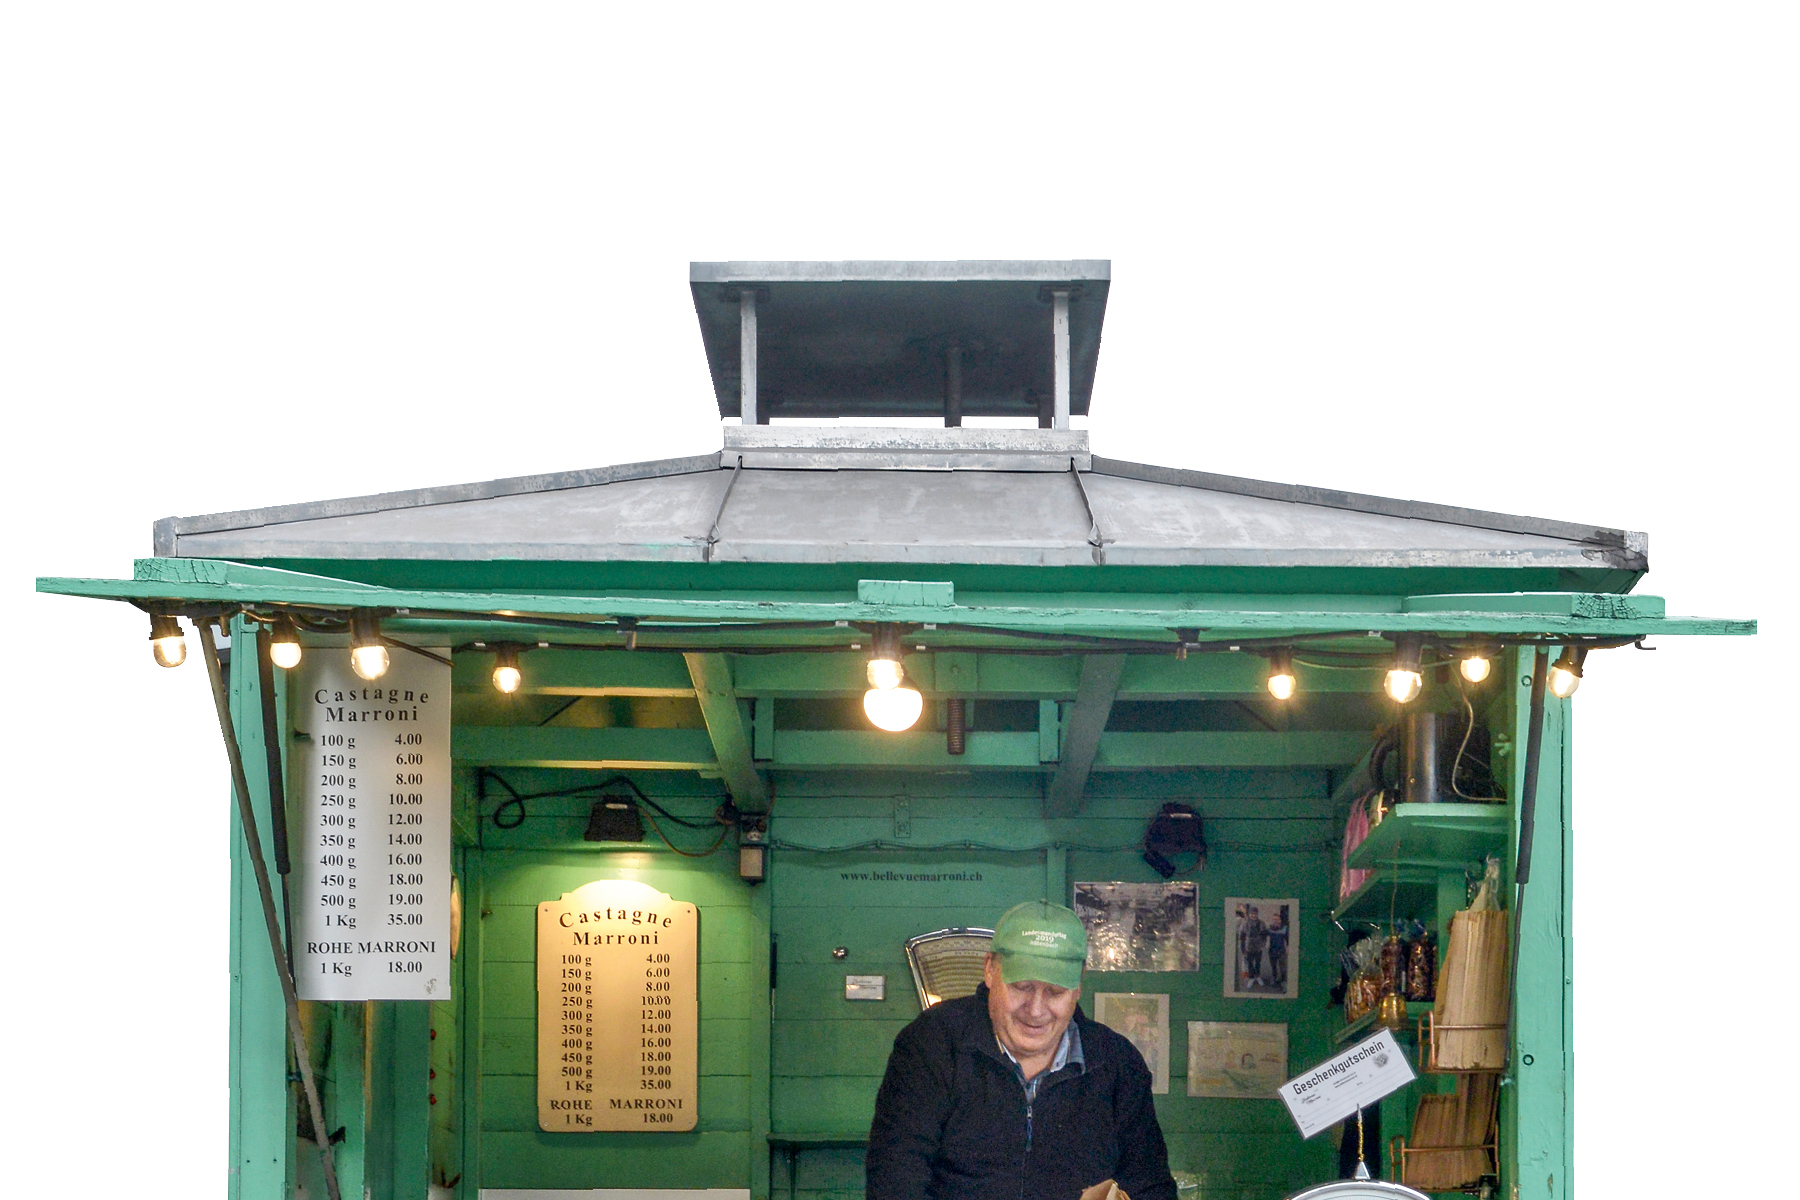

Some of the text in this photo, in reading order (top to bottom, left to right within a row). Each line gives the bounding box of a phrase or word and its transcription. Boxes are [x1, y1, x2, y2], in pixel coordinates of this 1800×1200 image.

[314, 688, 428, 704] Castagne
[326, 706, 417, 721] Marroni
[321, 734, 422, 749] 100 g 4.00
[322, 754, 422, 769] 150 g 6.00
[321, 774, 422, 789] 200 g 8.00
[320, 794, 422, 809] 250 g 10.00
[320, 814, 422, 829] 300 g 12.00
[319, 834, 422, 849] 350 g 14.00
[319, 854, 422, 869] 400 g 16.00
[320, 874, 423, 889] 450 g 18.00
[840, 871, 982, 881] www.bellevuemarroni.ch
[320, 894, 422, 909] 500 g 19.00
[326, 914, 422, 929] 1 Kg 35.00
[559, 908, 671, 927] Castagne
[573, 931, 658, 945] Marroni
[1035, 935, 1055, 943] 2019
[306, 942, 435, 953] ROHE MARRONI
[562, 954, 669, 967] 100 g 4.00
[321, 962, 422, 977] 1 Kg 18.00
[562, 968, 670, 981] 150 g 6.00
[561, 982, 669, 995] 200 g 8.00
[562, 996, 670, 1009] 250 g 10.00
[561, 1010, 671, 1023] 300 g 12.00
[561, 1024, 671, 1037] 350 g 14.00
[561, 1038, 671, 1051] 400 g 16.00
[561, 1052, 671, 1065] 450 g 18.00
[561, 1066, 671, 1079] 500 g 19.00
[1293, 1041, 1385, 1095] Geschenkgutschein
[566, 1080, 671, 1093] 1 Kg 35.00
[550, 1099, 682, 1110] ROHE MARRONI
[565, 1113, 673, 1126] 1 Kg 18.00
